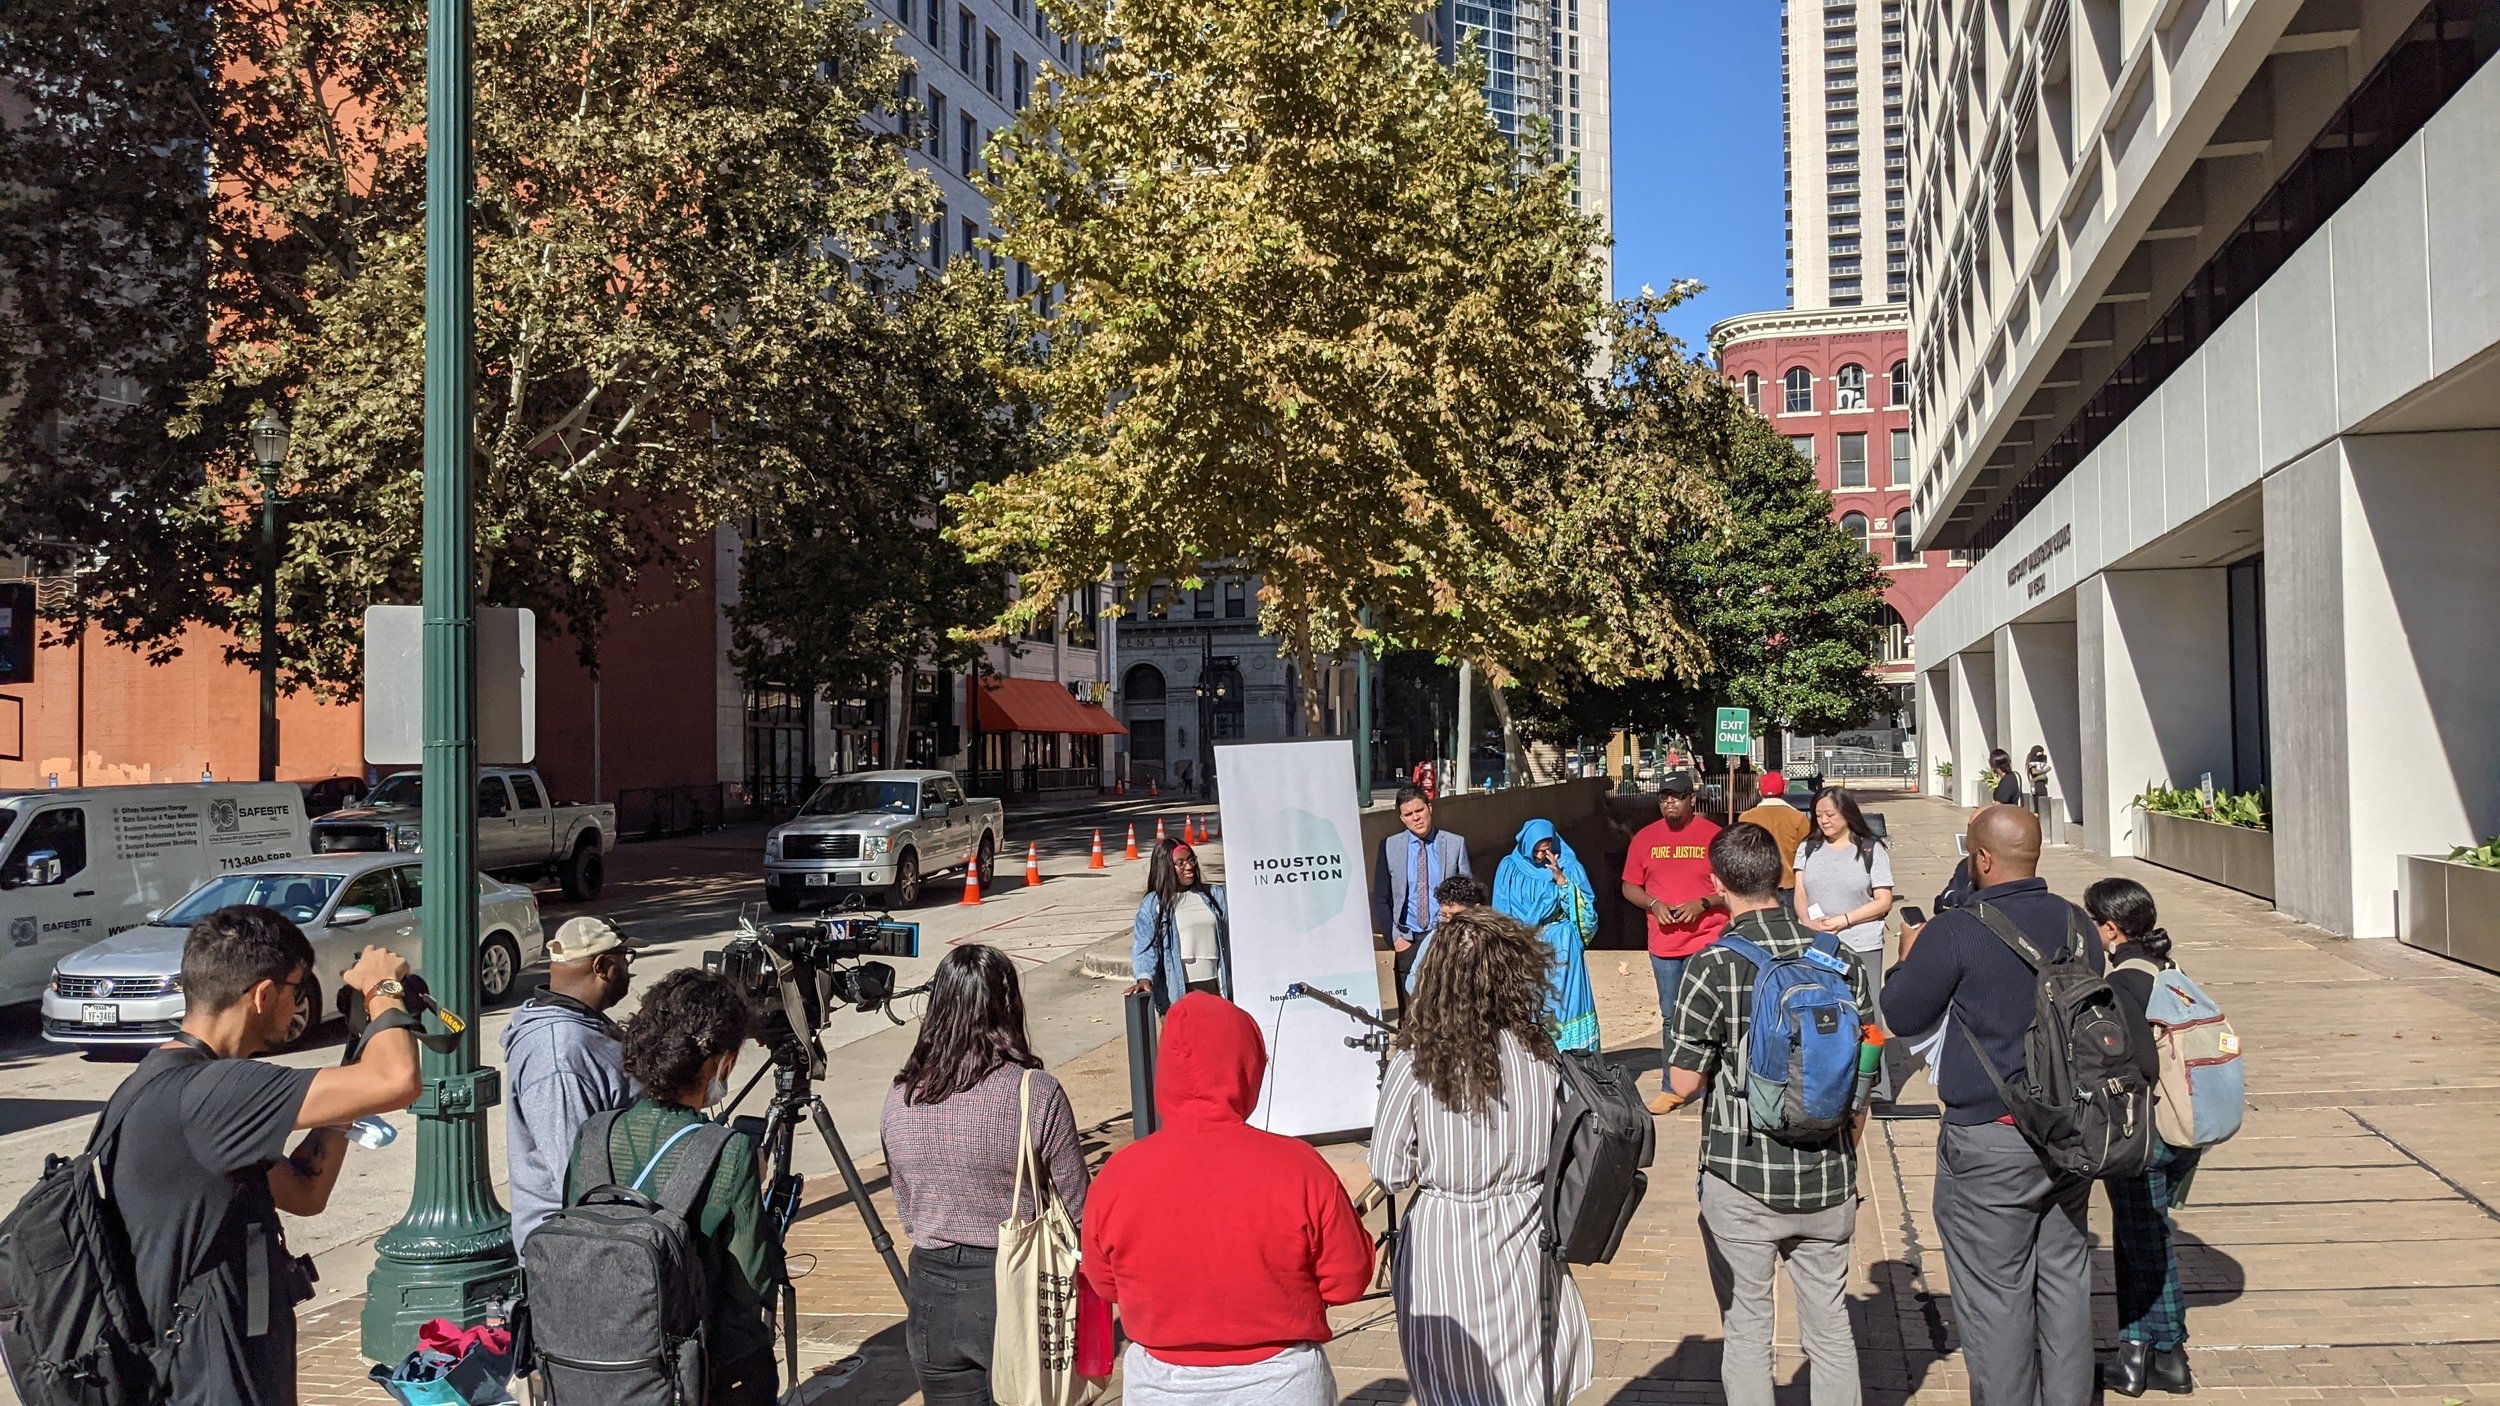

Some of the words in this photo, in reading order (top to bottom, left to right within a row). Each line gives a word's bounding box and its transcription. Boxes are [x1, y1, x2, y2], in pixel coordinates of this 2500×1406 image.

[1124, 638, 1155, 649] ENS
[1075, 680, 1110, 702] SUBWAY
[1720, 720, 1745, 730] EXIT
[1718, 732, 1746, 743] ONLY
[239, 805, 290, 817] SAFESITE
[1650, 845, 1671, 860] PURE
[1672, 845, 1706, 859] JUSTICE
[1253, 854, 1341, 870] HOUSTON
[1254, 874, 1268, 885] IN
[1273, 869, 1342, 884] ACTION
[43, 918, 92, 932] SAFESITE
